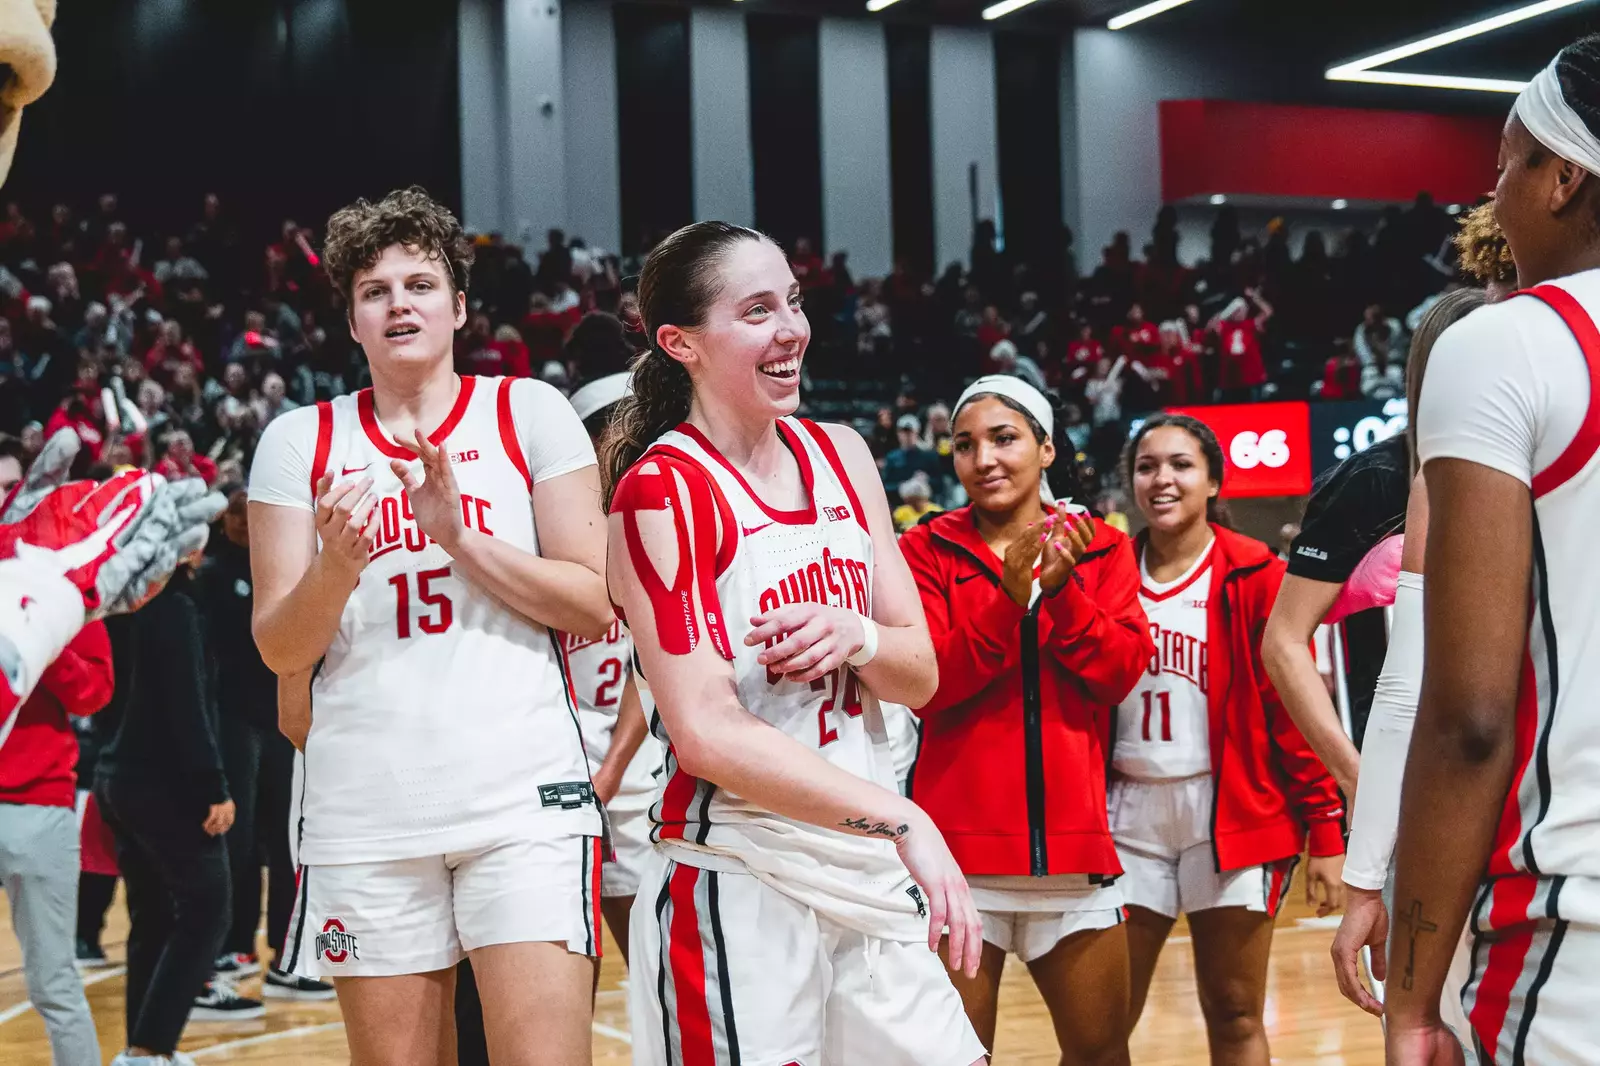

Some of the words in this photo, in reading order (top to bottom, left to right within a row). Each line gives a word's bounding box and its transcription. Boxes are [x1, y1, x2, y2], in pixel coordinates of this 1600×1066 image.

[1230, 429, 1290, 469] 66
[388, 567, 453, 640] 15
[1141, 691, 1172, 741] 11
